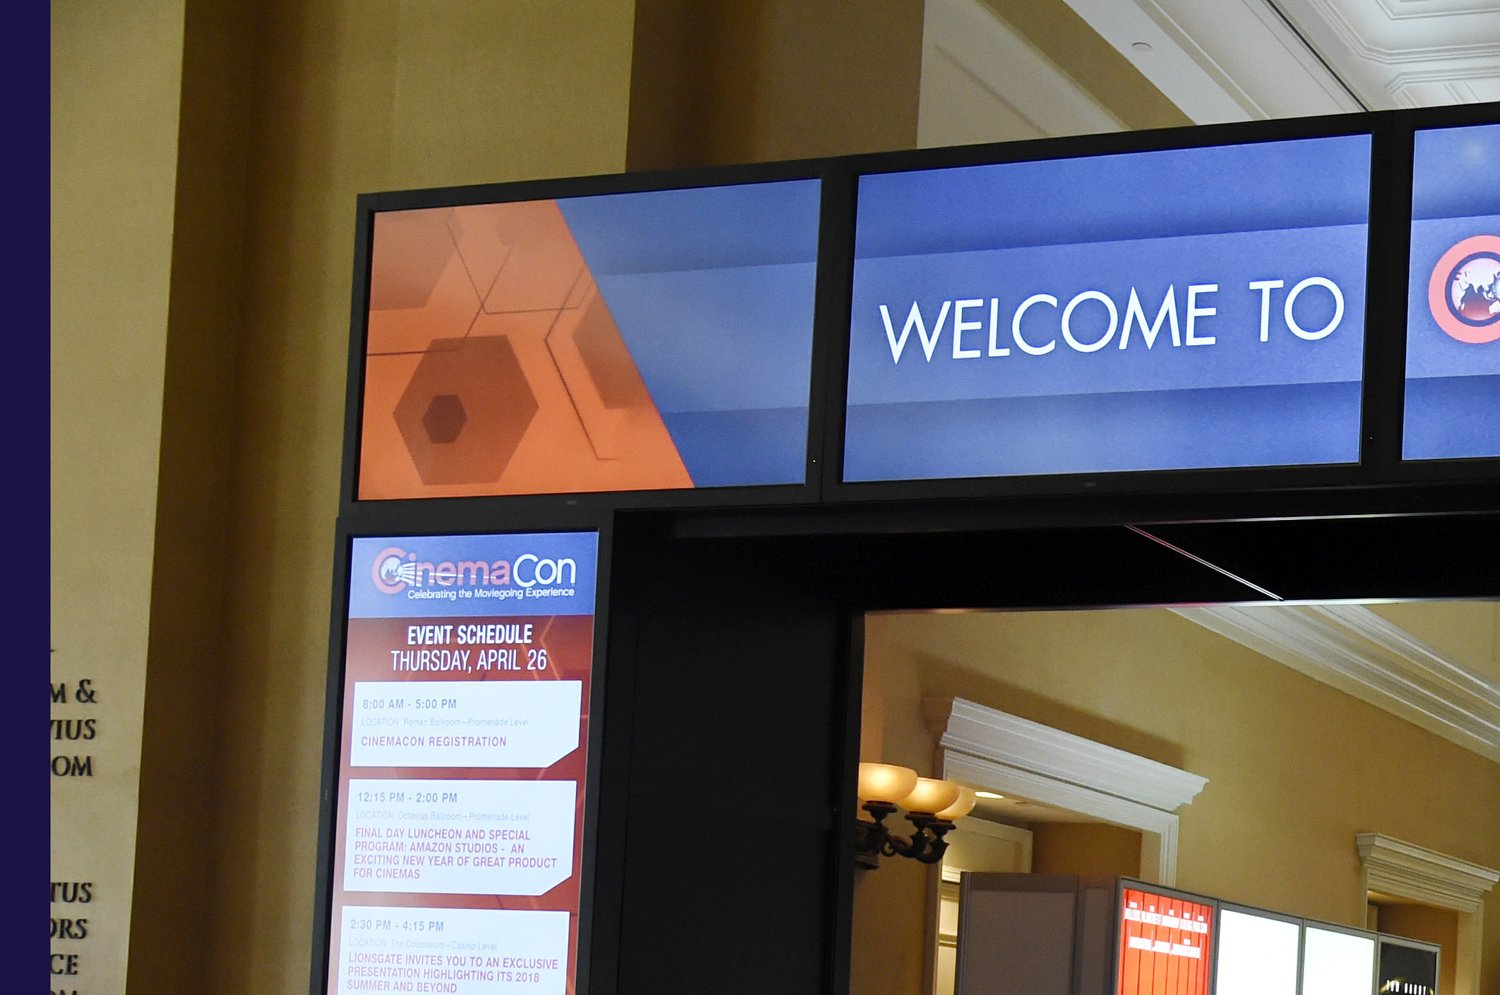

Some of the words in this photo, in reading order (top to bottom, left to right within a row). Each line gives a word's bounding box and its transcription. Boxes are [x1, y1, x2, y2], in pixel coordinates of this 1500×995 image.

[880, 284, 1218, 364] WELCOME
[1249, 277, 1344, 342] TO
[372, 546, 576, 595] CinemaCon
[408, 590, 456, 600] Celebrating
[459, 589, 472, 598] the
[475, 589, 523, 600] Moviegoing
[526, 587, 574, 598] Experience
[408, 626, 453, 645] EVENT
[457, 624, 532, 644] SCHEDULE
[391, 650, 471, 674] THURSDAY,
[477, 650, 521, 670] APRIL
[527, 649, 546, 670] 26
[75, 679, 97, 704] &
[361, 736, 424, 746] CINEMACON
[429, 736, 506, 747] REGISTRATION
